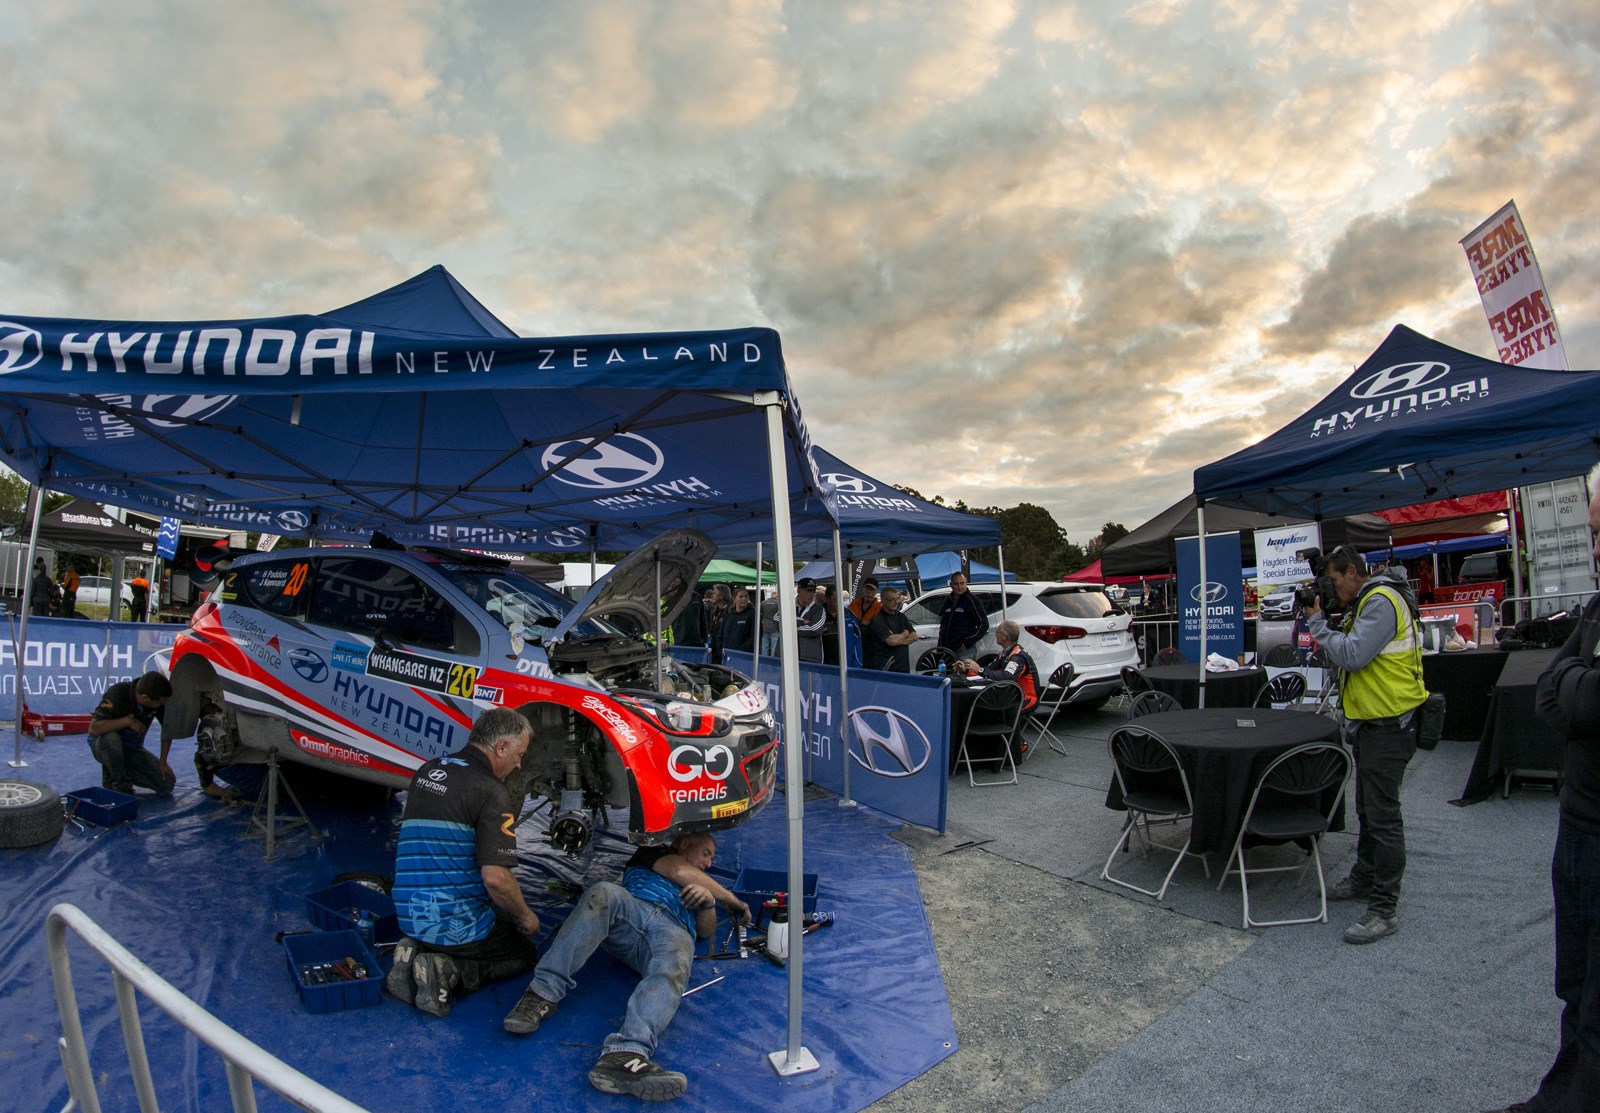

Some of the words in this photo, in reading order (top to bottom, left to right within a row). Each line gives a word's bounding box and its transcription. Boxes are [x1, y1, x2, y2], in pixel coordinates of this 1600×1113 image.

[60, 328, 375, 376] HYUNDAI
[396, 351, 495, 374] NEW
[538, 343, 761, 370] ZEALAND
[1310, 423, 1356, 438] NEW
[1375, 391, 1489, 422] ZEALAND
[1313, 377, 1488, 431] HYUNDAI
[1267, 535, 1308, 547] hayden
[262, 570, 267, 578] H
[267, 570, 288, 579] Paddon
[1263, 557, 1287, 568] Hayden
[1263, 569, 1285, 579] Special
[1287, 567, 1310, 576] Edition
[263, 578, 287, 587] Kennard
[282, 563, 309, 596] 20
[1454, 588, 1495, 602] torque
[1185, 605, 1234, 617] HYNDAI
[227, 610, 267, 641] provident
[1198, 623, 1235, 631] PSSIBILITIES.
[239, 633, 281, 669] insurance
[371, 653, 428, 680] WHANGAREI
[429, 666, 445, 684] NZ
[448, 664, 477, 698] 20
[477, 687, 496, 699] BNT
[333, 671, 454, 748] HYUNDAI
[330, 695, 361, 718] NEW
[371, 717, 450, 757] ZEALAND
[300, 736, 369, 764] Omnigraphics
[667, 744, 734, 782] GO
[417, 778, 448, 793] HYUNDAI
[669, 783, 728, 803] rentals
